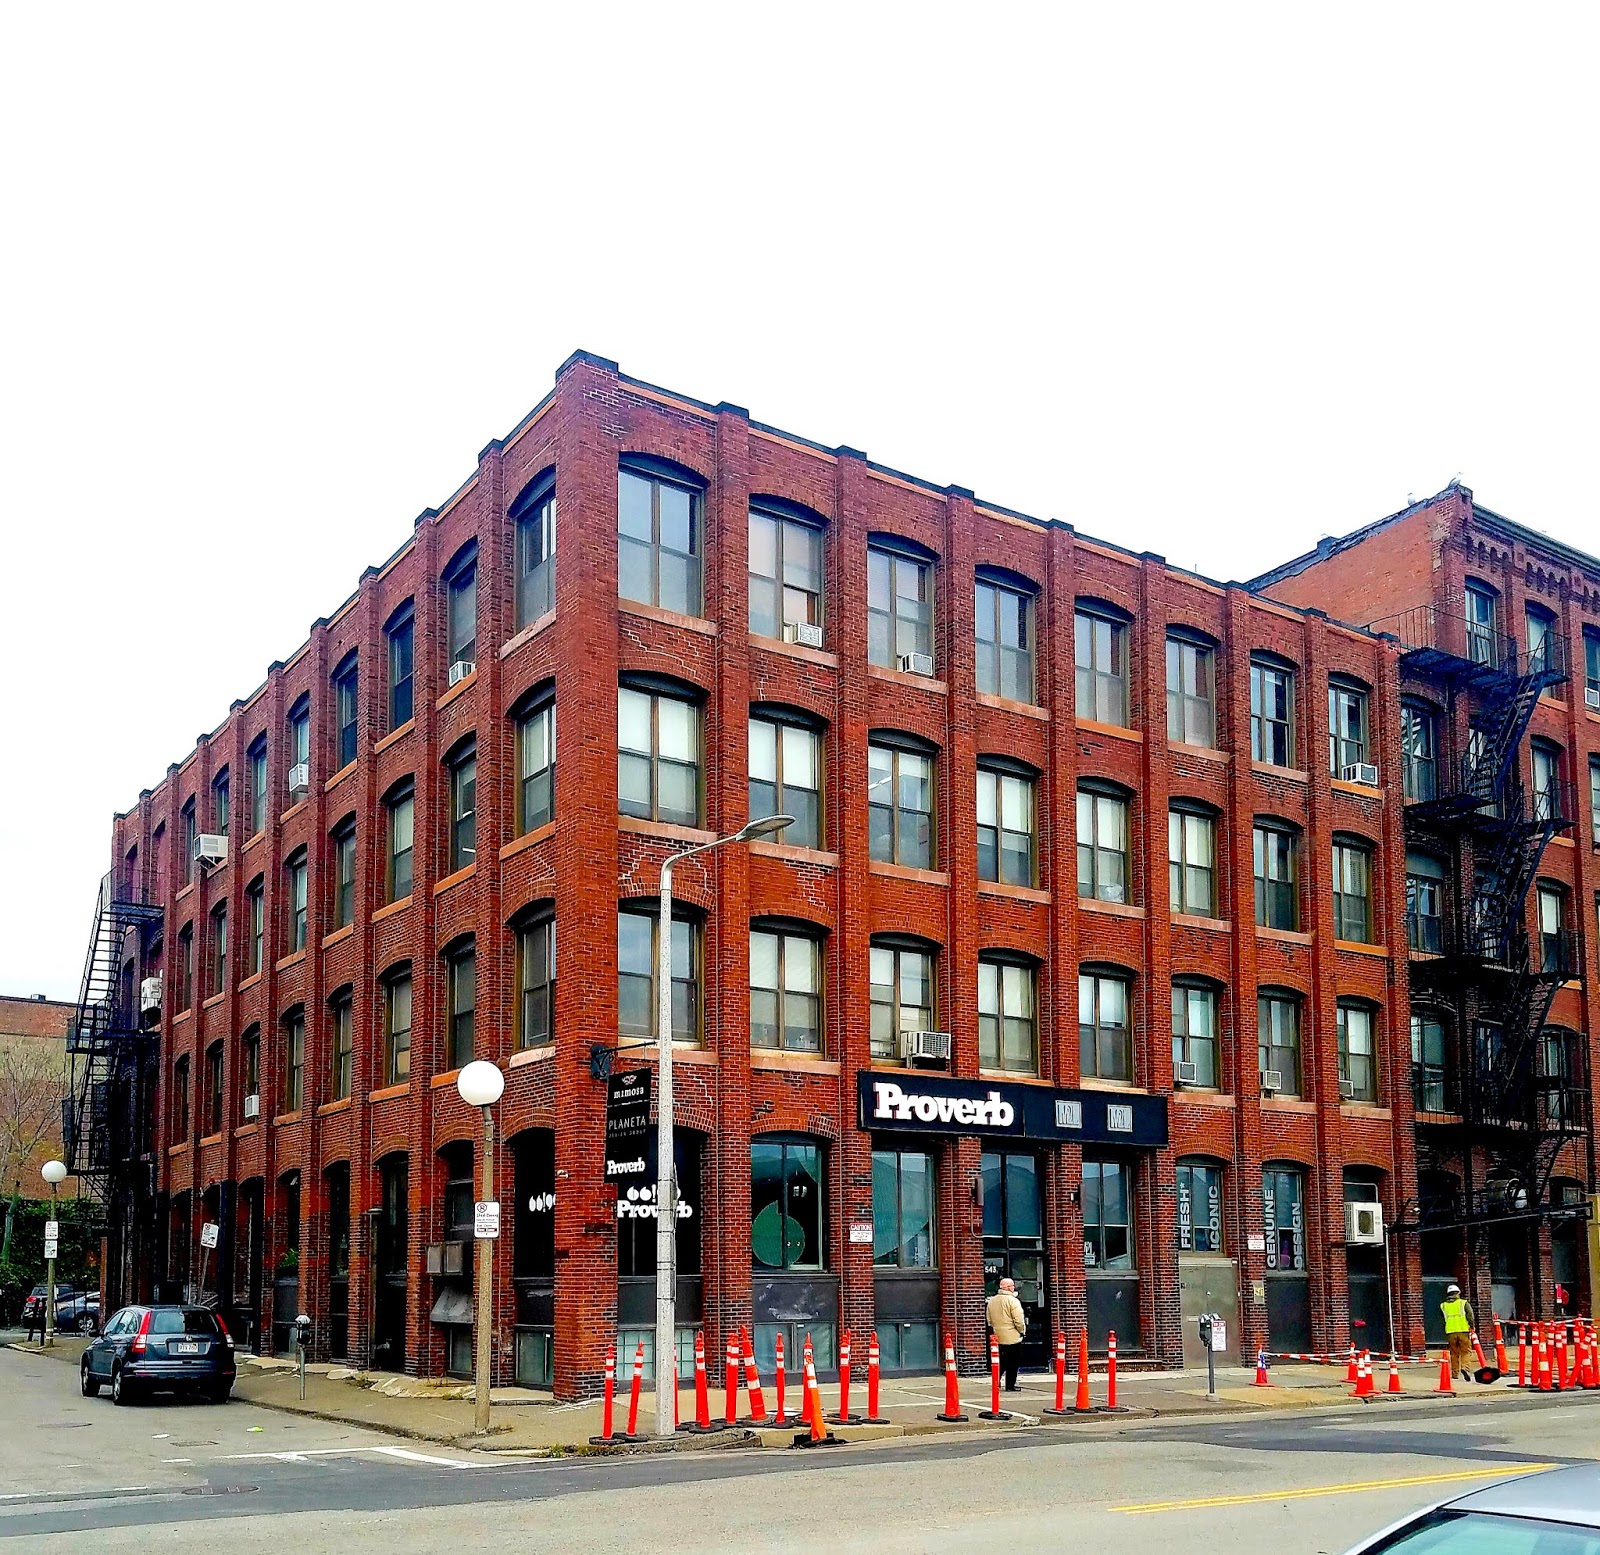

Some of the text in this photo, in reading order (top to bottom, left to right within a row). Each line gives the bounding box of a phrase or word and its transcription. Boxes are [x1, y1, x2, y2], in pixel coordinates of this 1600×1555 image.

[613, 1087, 645, 1099] mimosa
[873, 1082, 1014, 1126] Proverb
[608, 1115, 647, 1131] PLANETA
[606, 1156, 646, 1176] Proverb
[1209, 1185, 1220, 1249] ICONIC
[1264, 1189, 1277, 1268] GENUINE
[1292, 1202, 1304, 1270] DESIGN
[984, 1265, 997, 1273] 543
